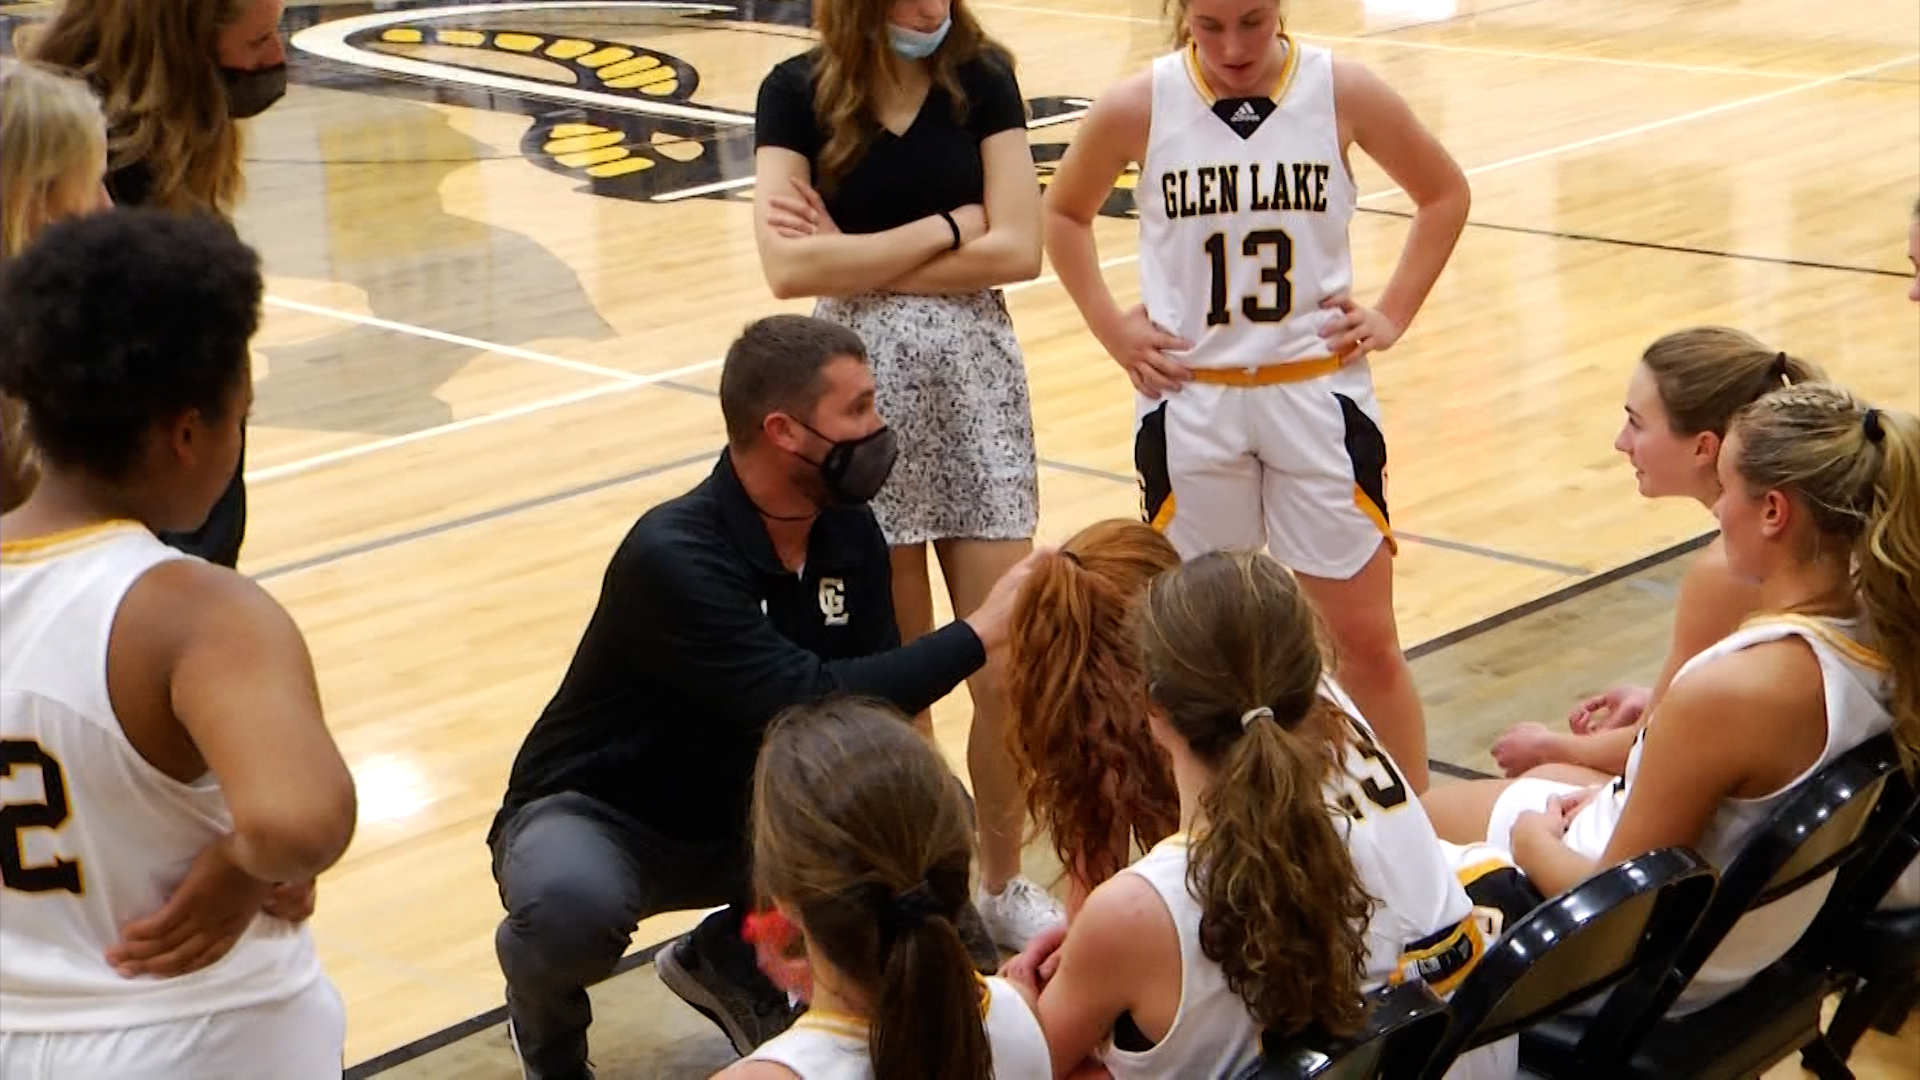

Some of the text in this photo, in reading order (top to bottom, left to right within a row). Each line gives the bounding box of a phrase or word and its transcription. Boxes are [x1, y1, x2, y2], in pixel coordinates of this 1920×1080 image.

[1161, 162, 1330, 219] GLEN LAKE
[1204, 228, 1293, 327] 13
[0, 738, 84, 895] 2
